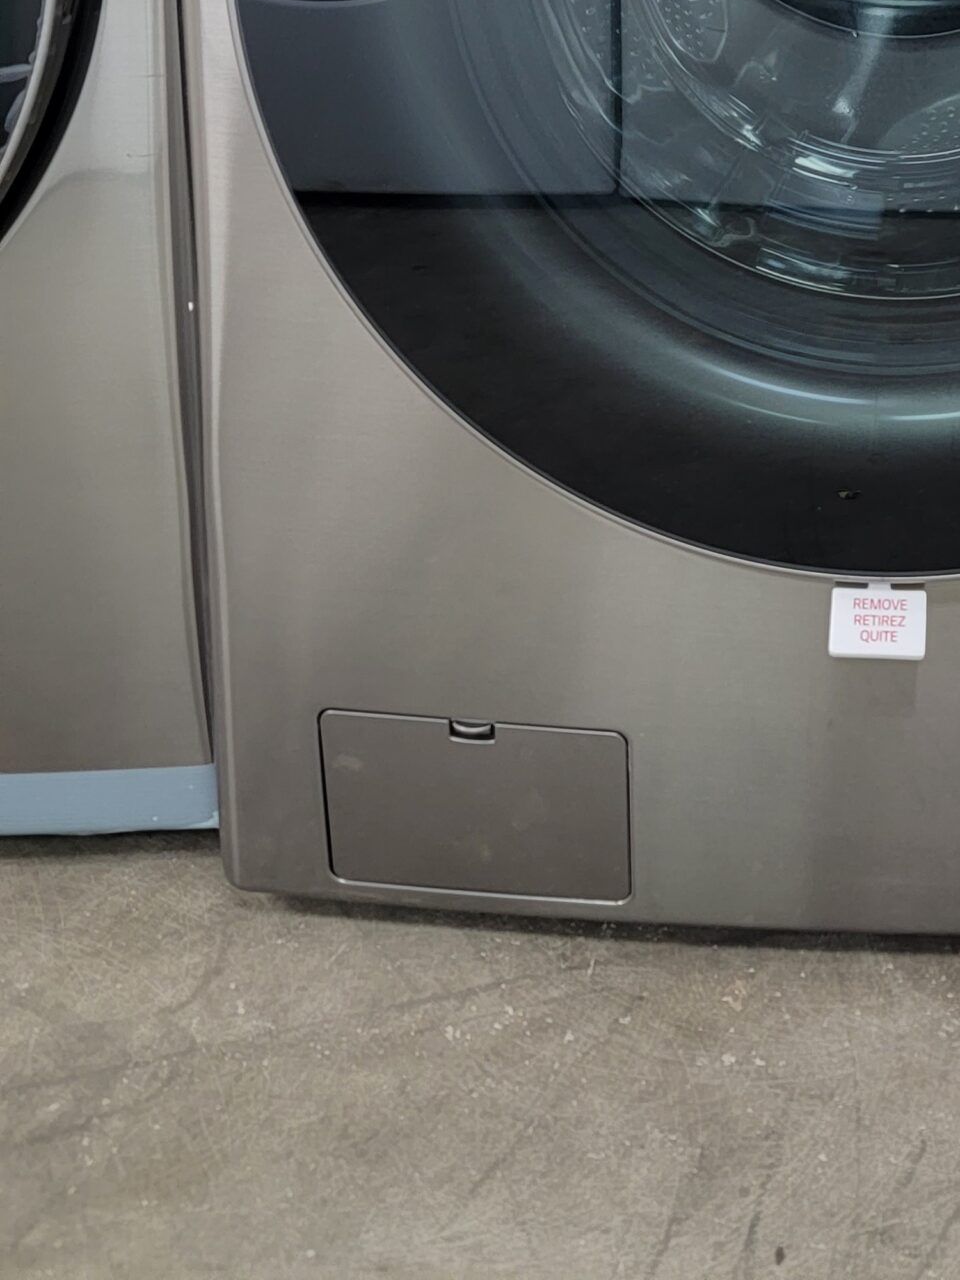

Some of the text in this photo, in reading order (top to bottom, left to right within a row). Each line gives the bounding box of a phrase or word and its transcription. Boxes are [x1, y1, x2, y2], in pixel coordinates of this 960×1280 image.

[853, 597, 909, 612] REMOVE
[853, 614, 907, 628] RETIREZ
[859, 629, 899, 644] QUITE
